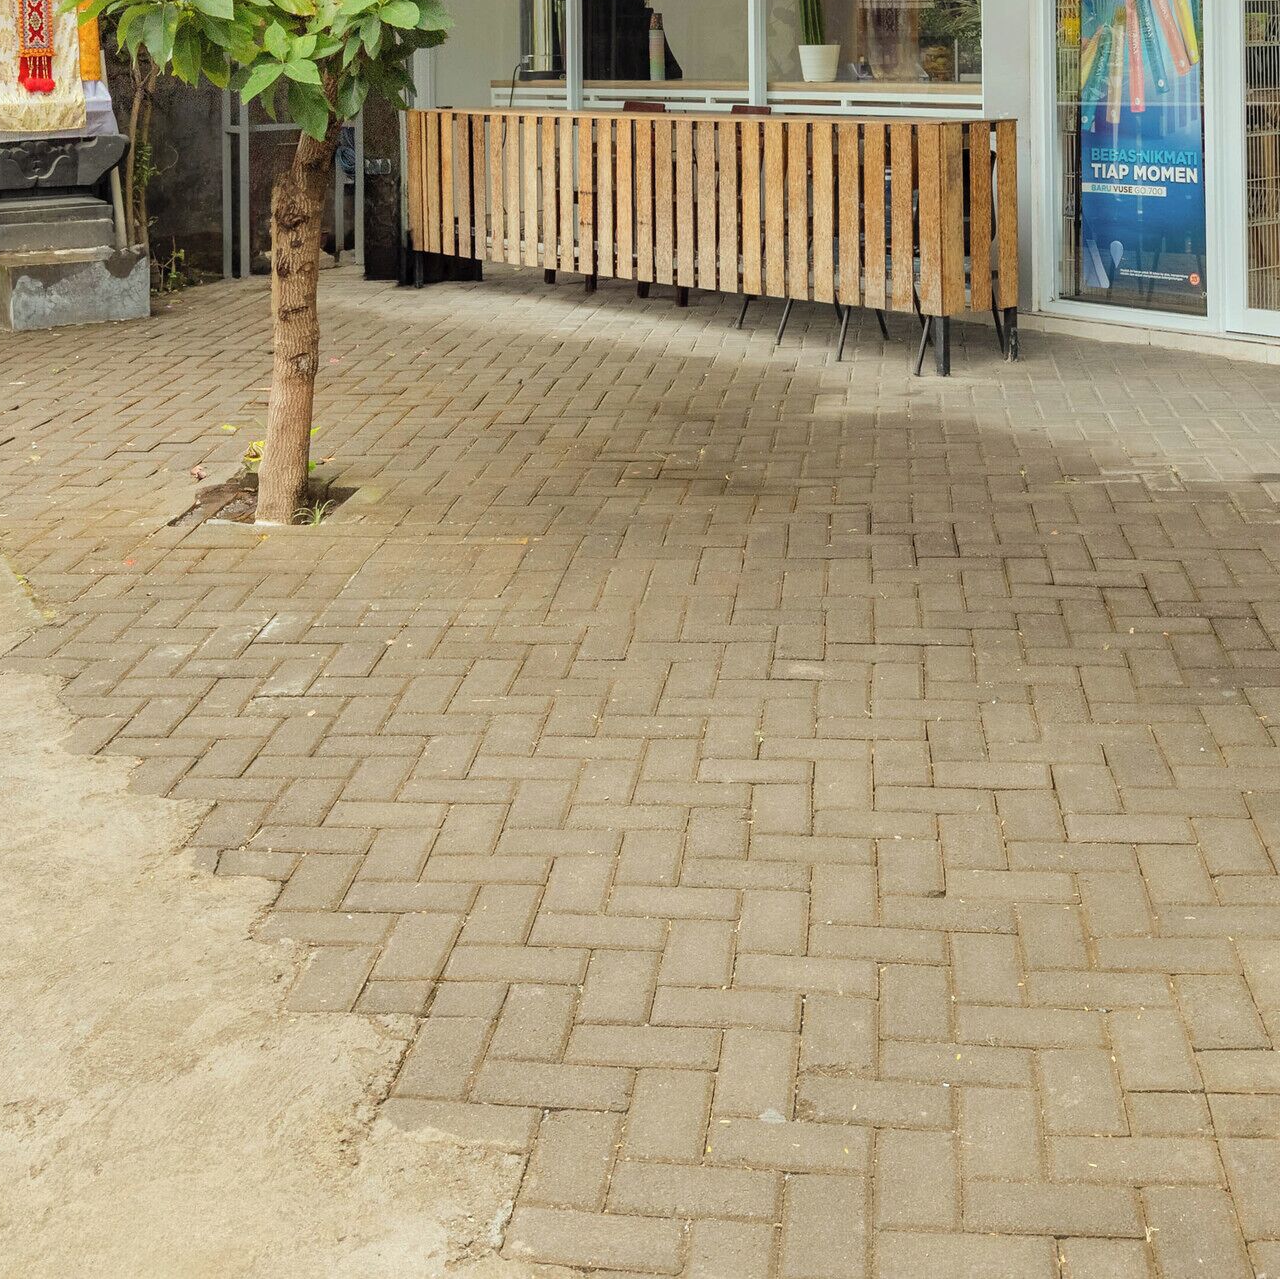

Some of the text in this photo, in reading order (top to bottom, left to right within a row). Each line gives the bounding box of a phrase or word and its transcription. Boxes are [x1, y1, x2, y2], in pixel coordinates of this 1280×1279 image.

[1091, 147, 1197, 165] BEBAS NIKMATI
[1091, 163, 1198, 184] TIAP MOMEN
[1091, 184, 1112, 193] BARU
[1113, 185, 1133, 194] VUSE
